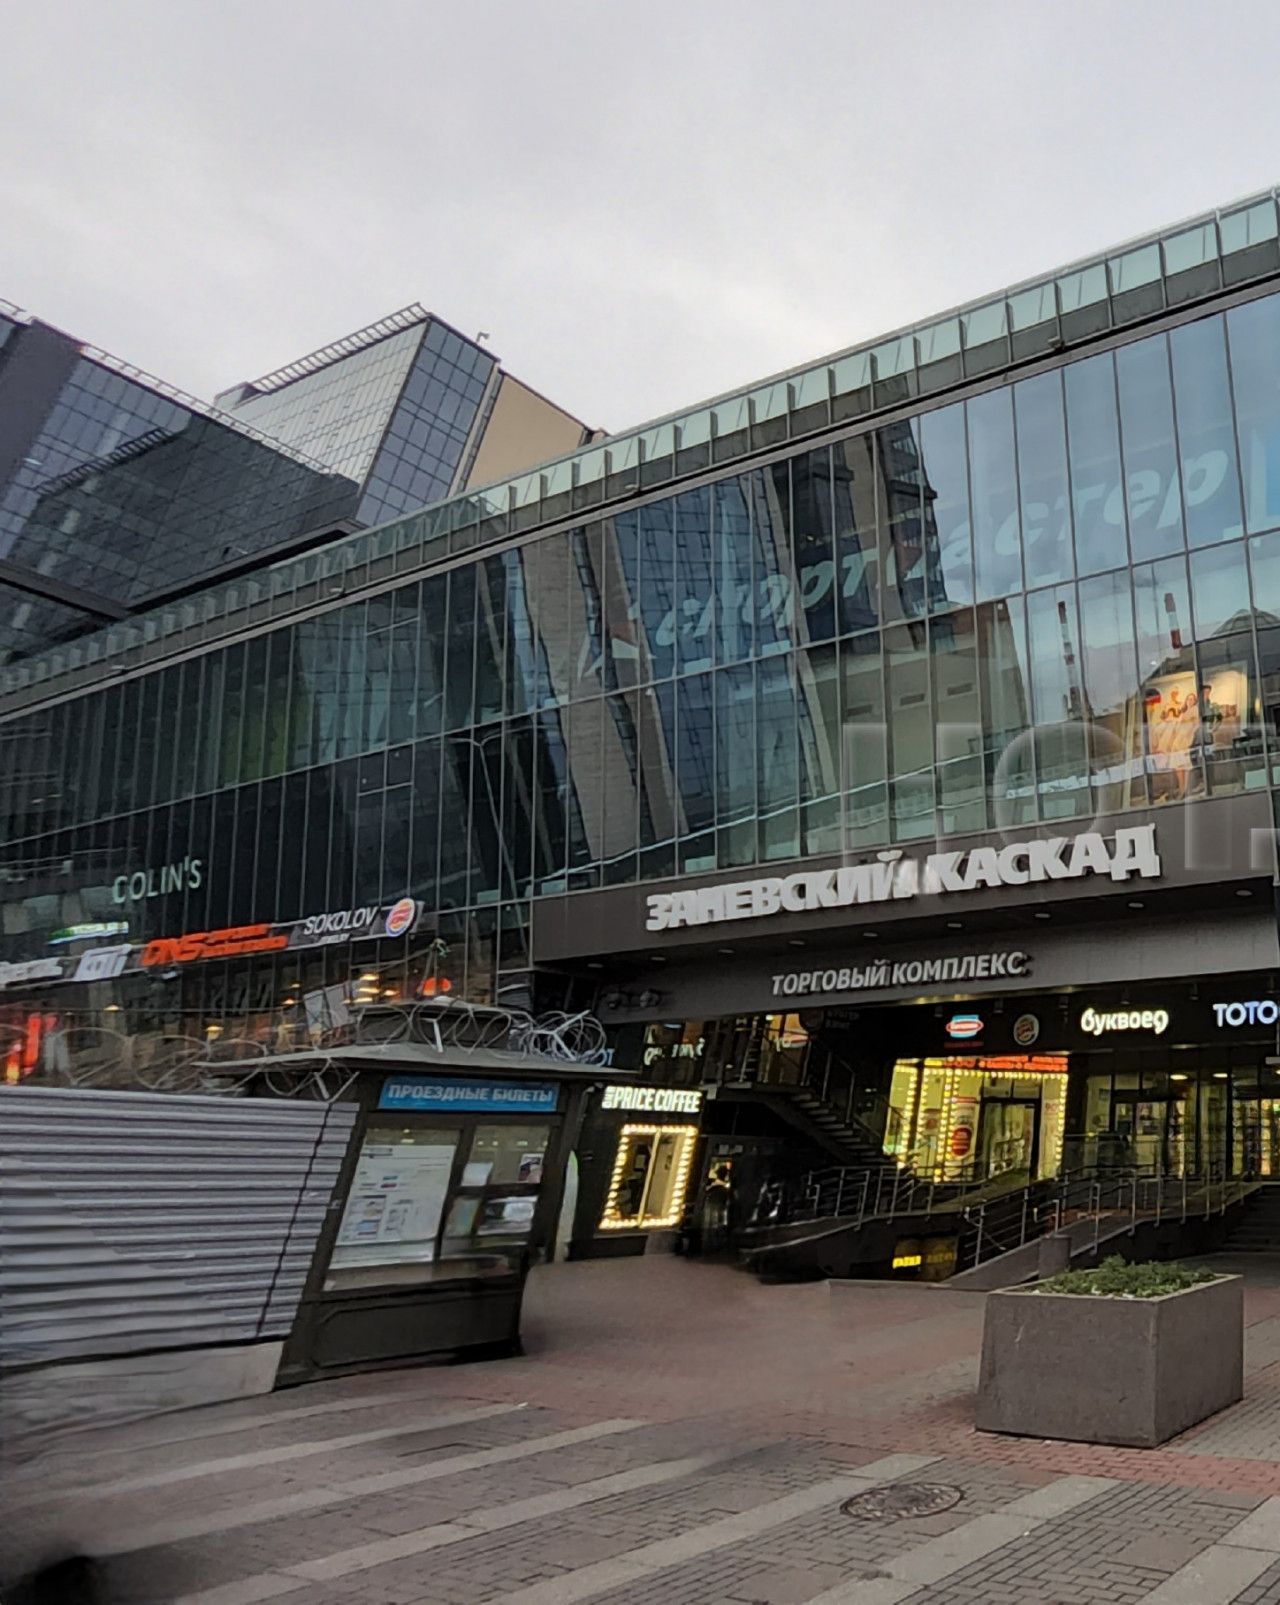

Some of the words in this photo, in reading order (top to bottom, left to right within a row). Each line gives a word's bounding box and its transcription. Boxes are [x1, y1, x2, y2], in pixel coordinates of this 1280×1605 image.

[112, 856, 202, 904] COLIN'S
[646, 850, 914, 932] ЗАНЕВСКИЙ
[922, 823, 1161, 894] КАСКАД
[303, 905, 379, 936] SOKOLOV
[771, 958, 888, 997] ТОРГОВЫЙ
[891, 951, 1028, 986] КОМПЛЕКС
[1080, 1007, 1169, 1036] буквоед
[388, 1085, 489, 1101] ПРОЕЗДНЫЕ
[492, 1088, 553, 1102] БИЛЕТЫ
[612, 1086, 656, 1111] PRICE
[654, 1089, 702, 1112] COFFEE
